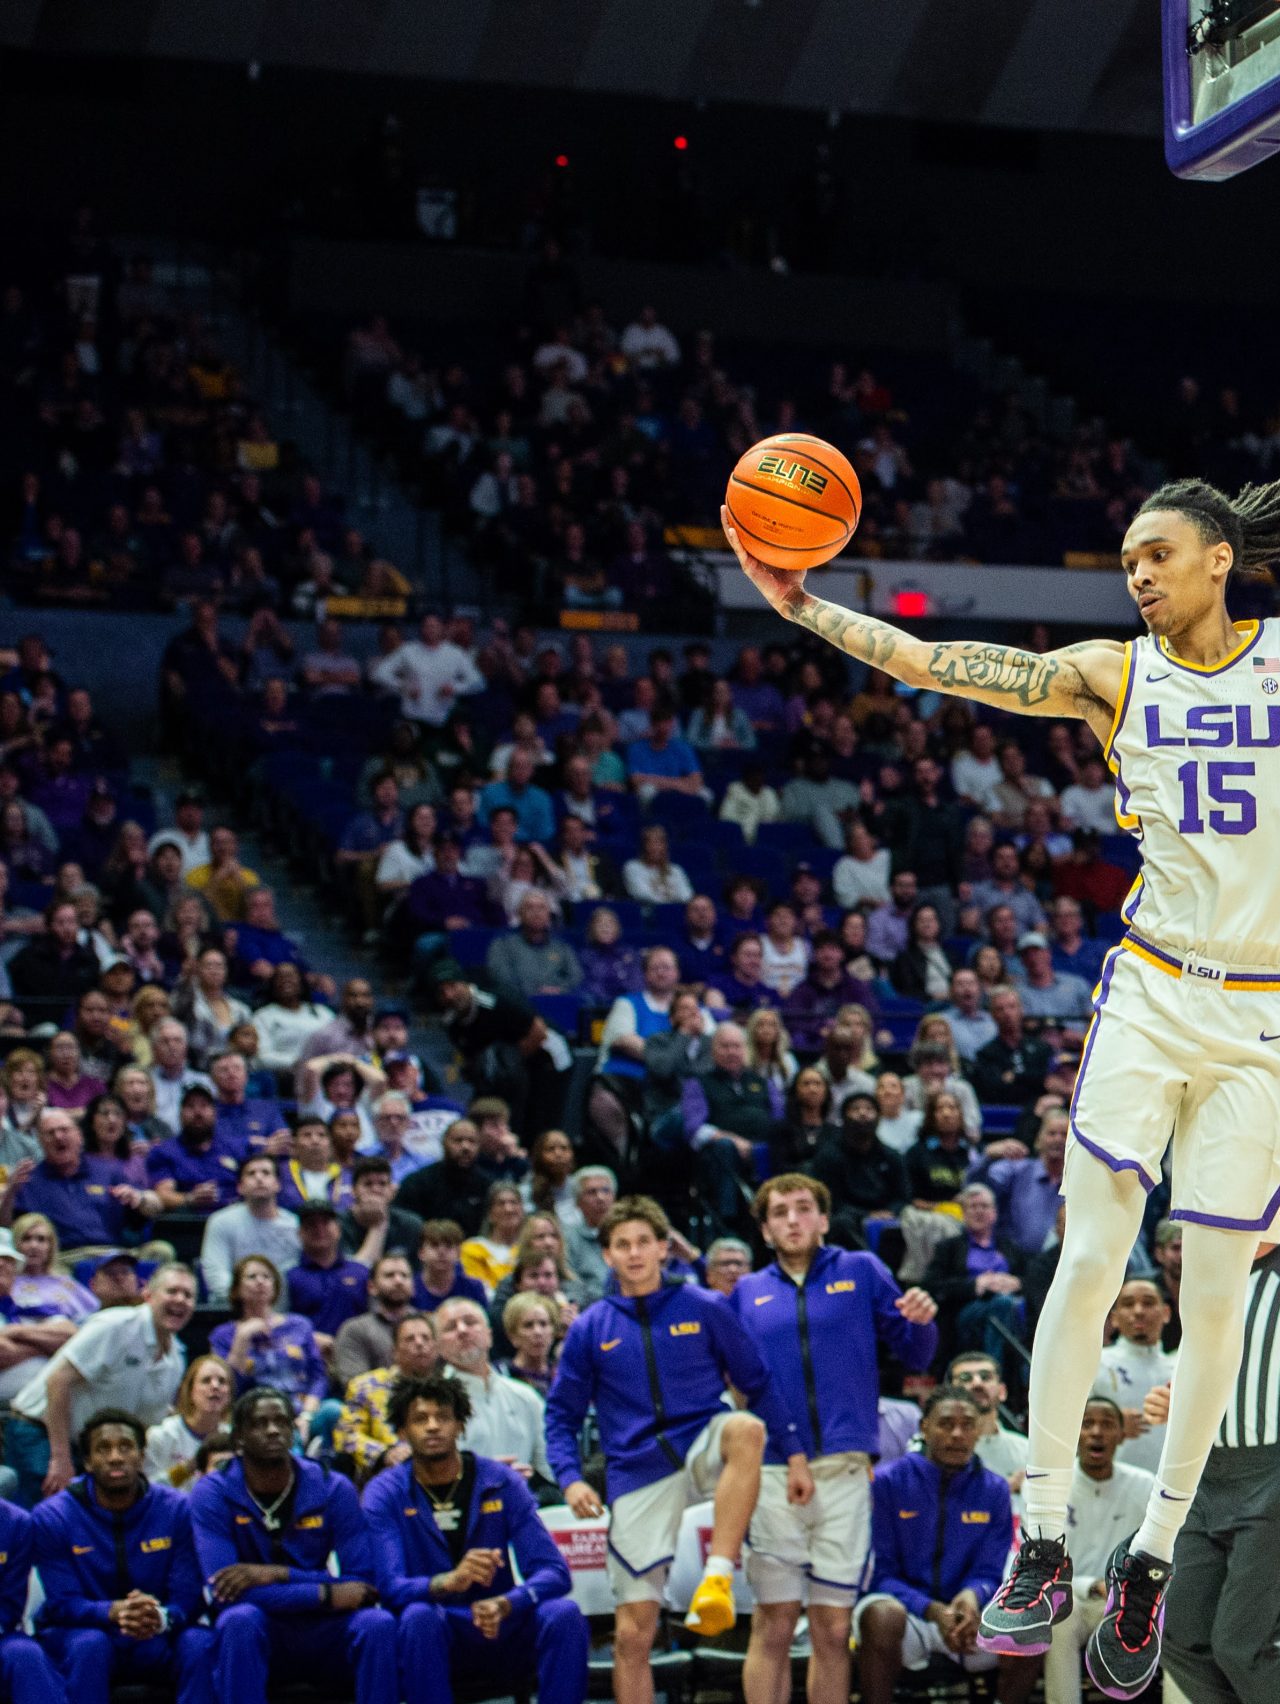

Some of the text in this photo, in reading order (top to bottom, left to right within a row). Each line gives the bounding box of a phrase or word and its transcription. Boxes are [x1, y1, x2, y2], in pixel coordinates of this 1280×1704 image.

[757, 456, 828, 495] ELITE
[1262, 678, 1278, 694] SEC
[1178, 761, 1257, 835] 15
[1187, 963, 1221, 980] LSU
[826, 1280, 855, 1294] LSU
[669, 1322, 700, 1336] LSU
[961, 1511, 990, 1524] LSU
[140, 1536, 171, 1553] LSU
